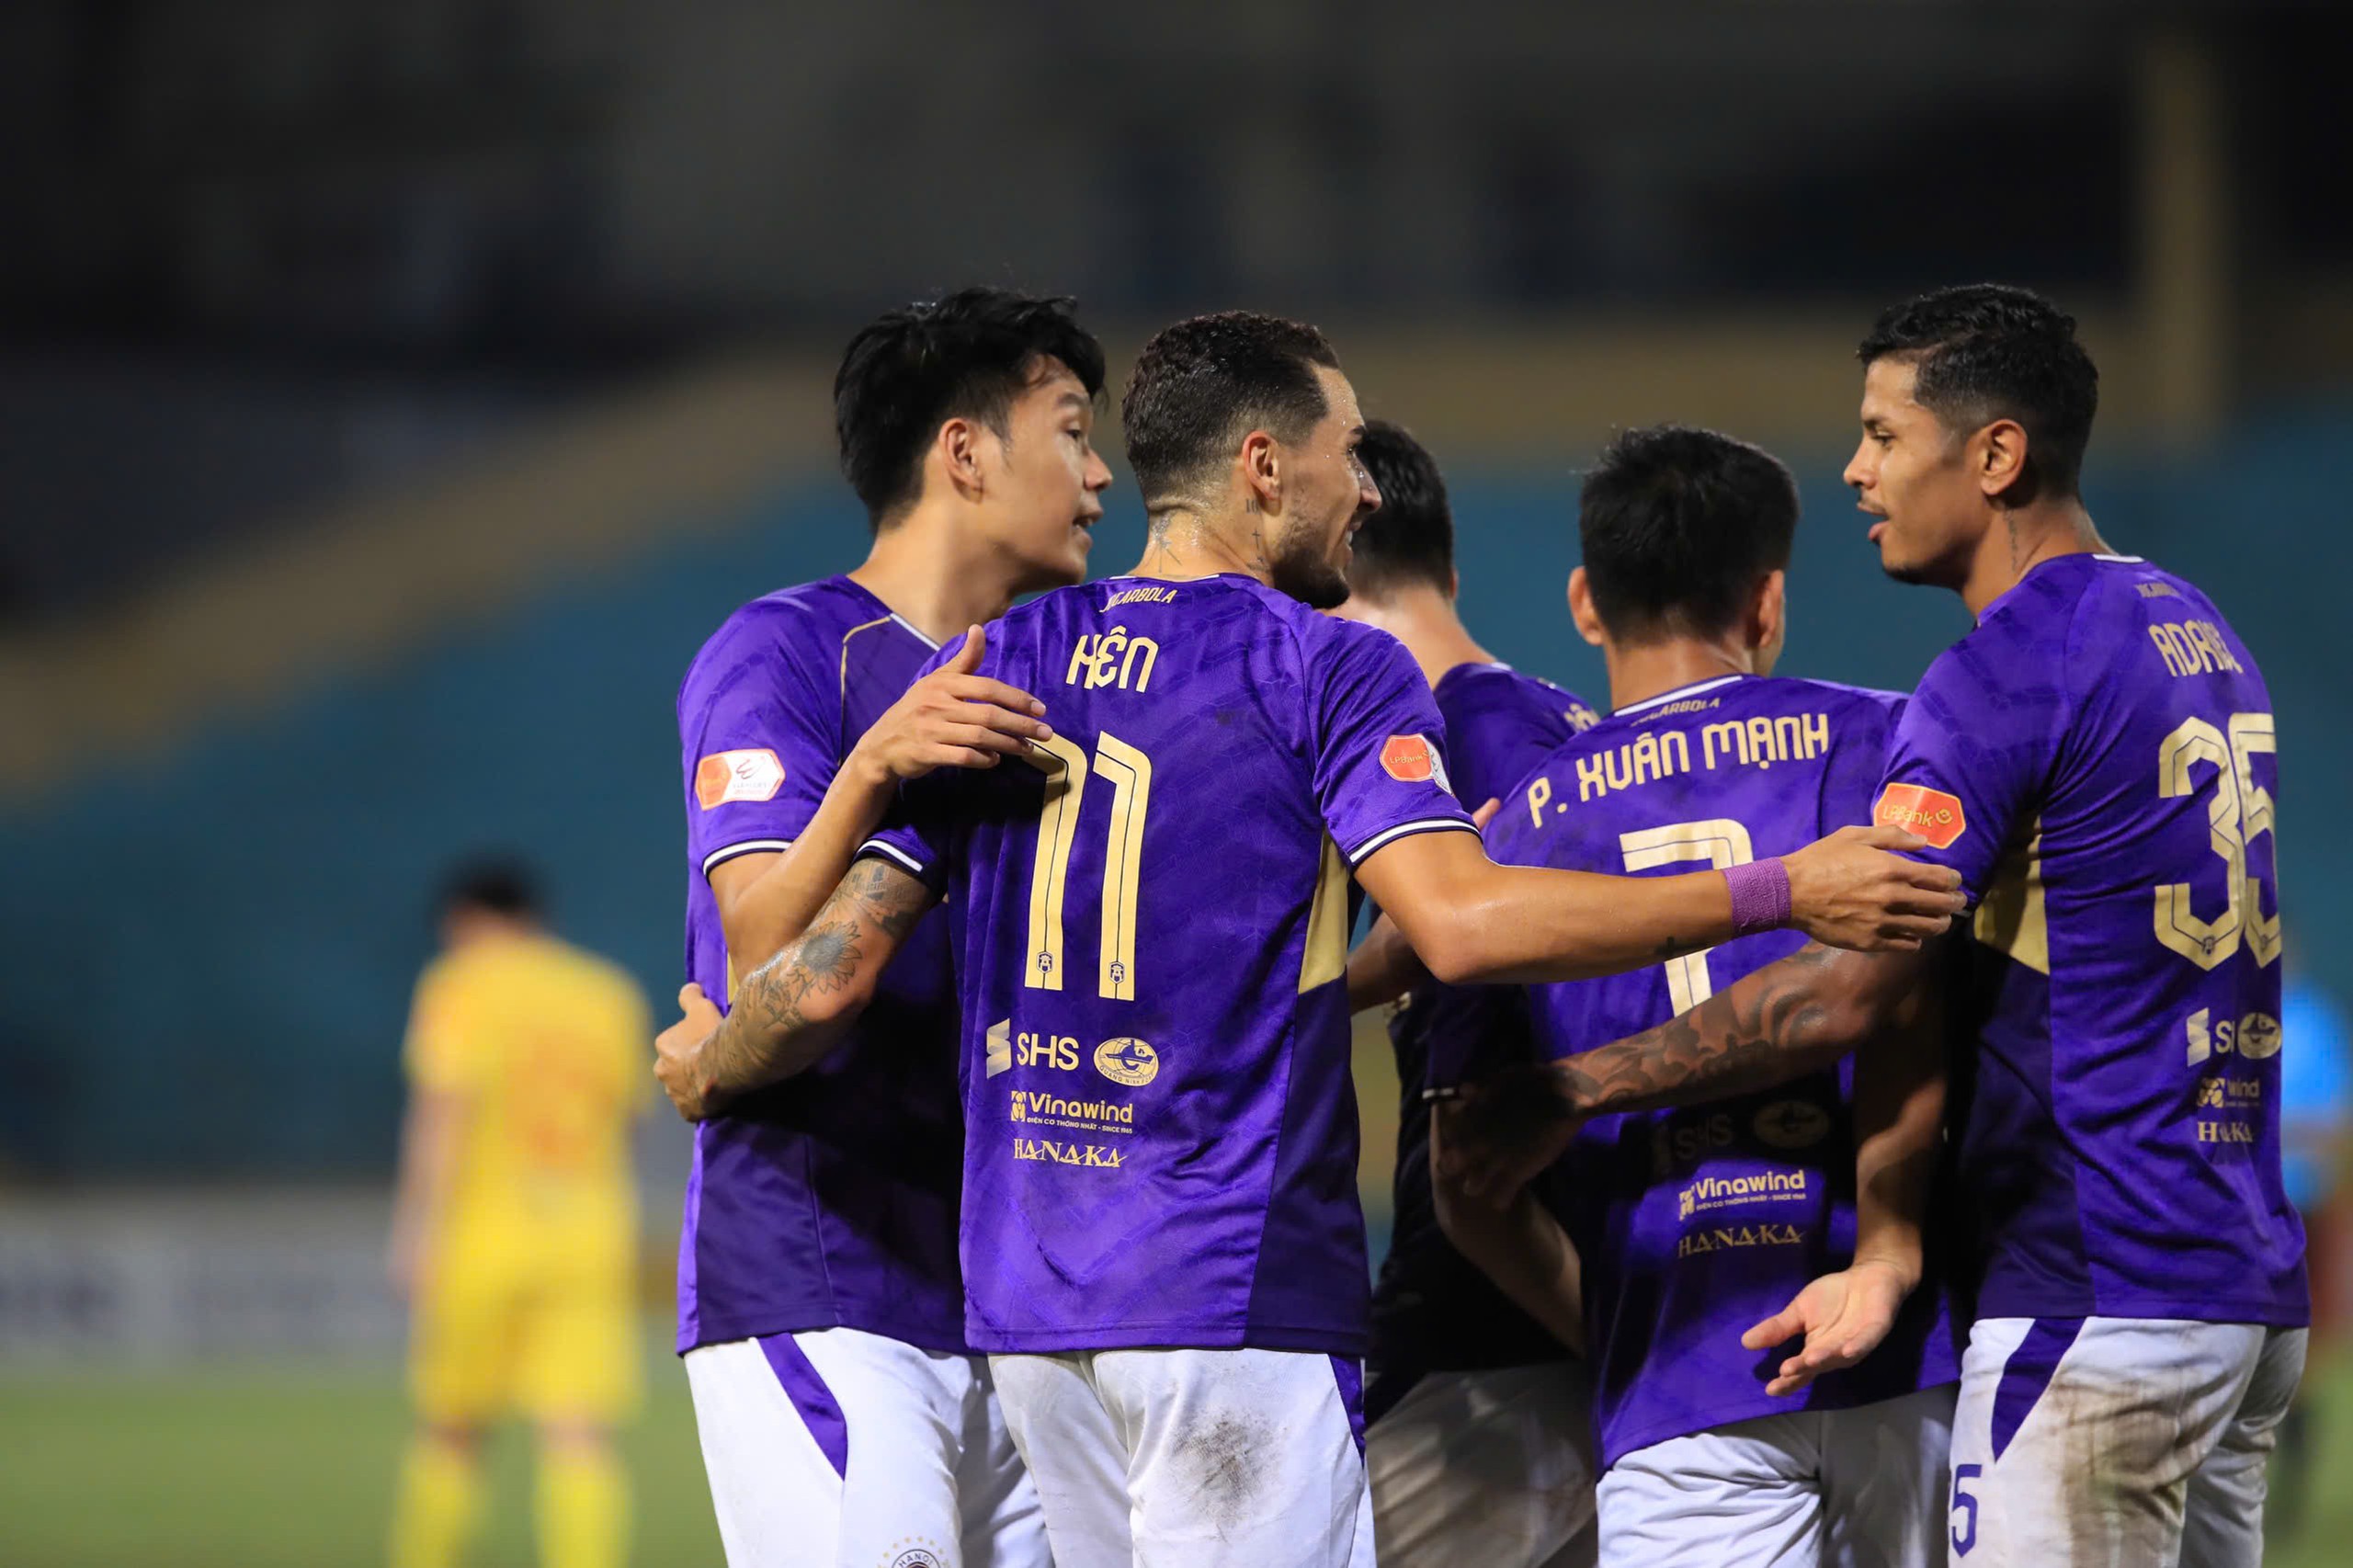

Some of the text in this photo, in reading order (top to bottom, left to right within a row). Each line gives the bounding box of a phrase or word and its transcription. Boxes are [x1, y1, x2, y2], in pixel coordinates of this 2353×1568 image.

[1065, 625, 1159, 693] HÊN
[1526, 712, 1829, 829] P. XUÂN MẠNH
[2154, 711, 2283, 972] 35
[1619, 817, 1756, 1017] 7
[1016, 1031, 1080, 1072] SHS
[1029, 1091, 1133, 1124] Vinawind
[1102, 1125, 1120, 1133] SINCE
[1014, 1137, 1129, 1168] HANAKA
[1695, 1169, 1806, 1200] Vinawind
[1677, 1223, 1807, 1260] HANAKA
